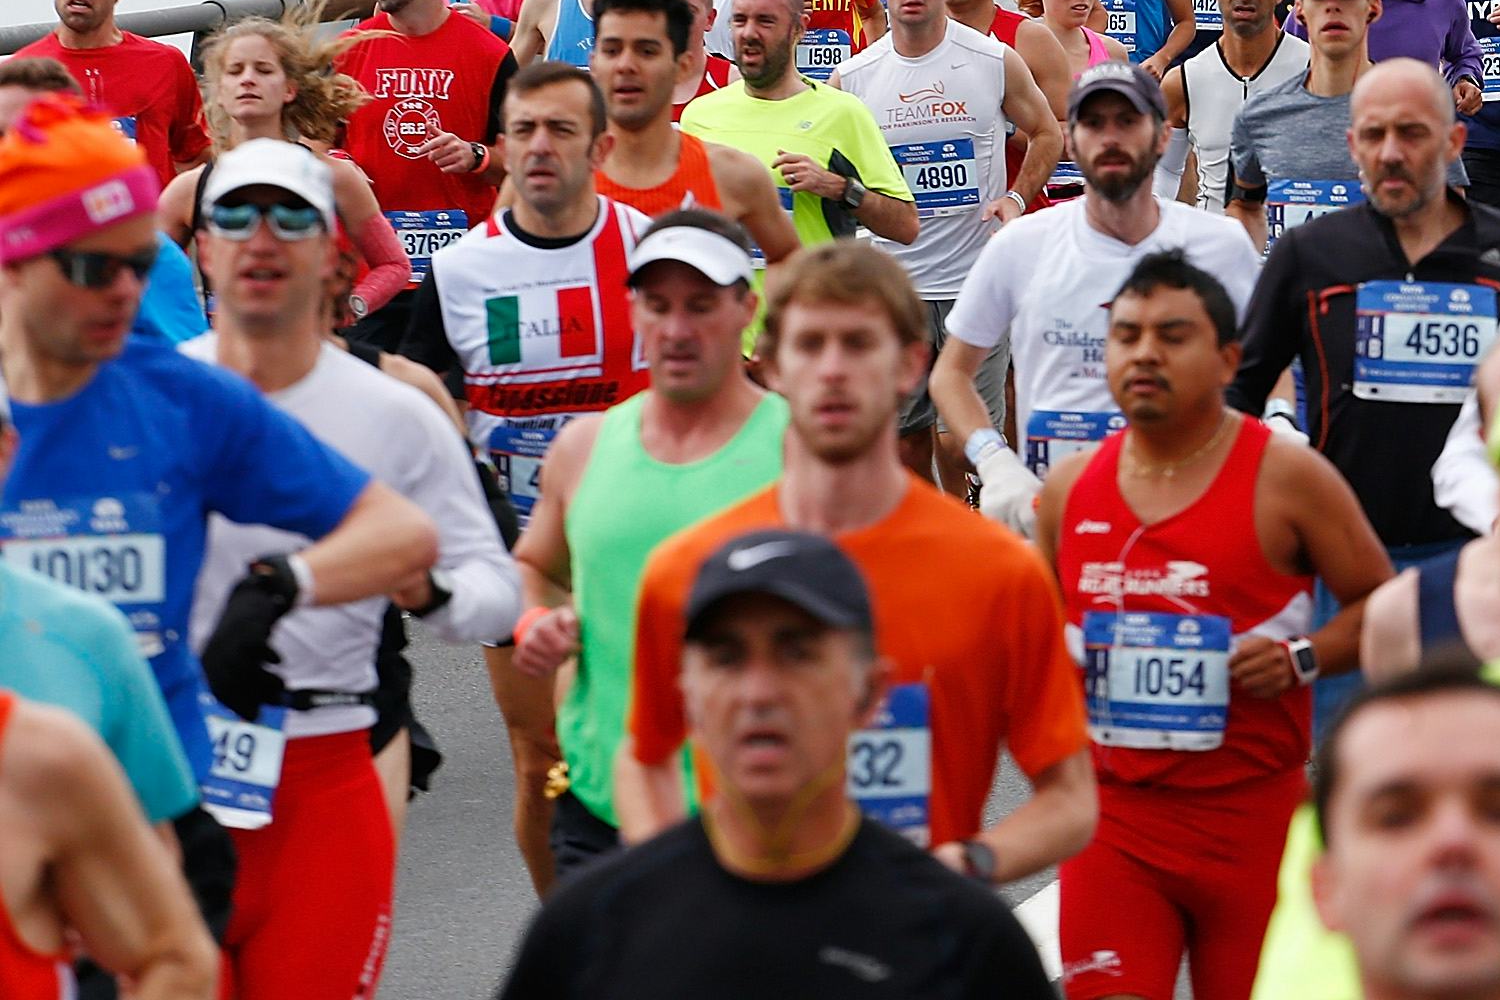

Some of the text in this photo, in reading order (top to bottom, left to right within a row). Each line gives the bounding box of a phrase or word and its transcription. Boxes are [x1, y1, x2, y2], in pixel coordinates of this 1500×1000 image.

[1109, 14, 1127, 31] 65
[808, 47, 842, 66] 1598
[375, 68, 454, 100] FDNY
[400, 122, 426, 135] 26.2
[894, 118, 940, 129] PARKINSON'S
[916, 164, 968, 190] 4890
[503, 317, 584, 344] ITALIA
[1405, 322, 1479, 357] 4536
[31, 547, 142, 593] 10130
[1134, 657, 1206, 697] 1054
[853, 740, 905, 788] 32
